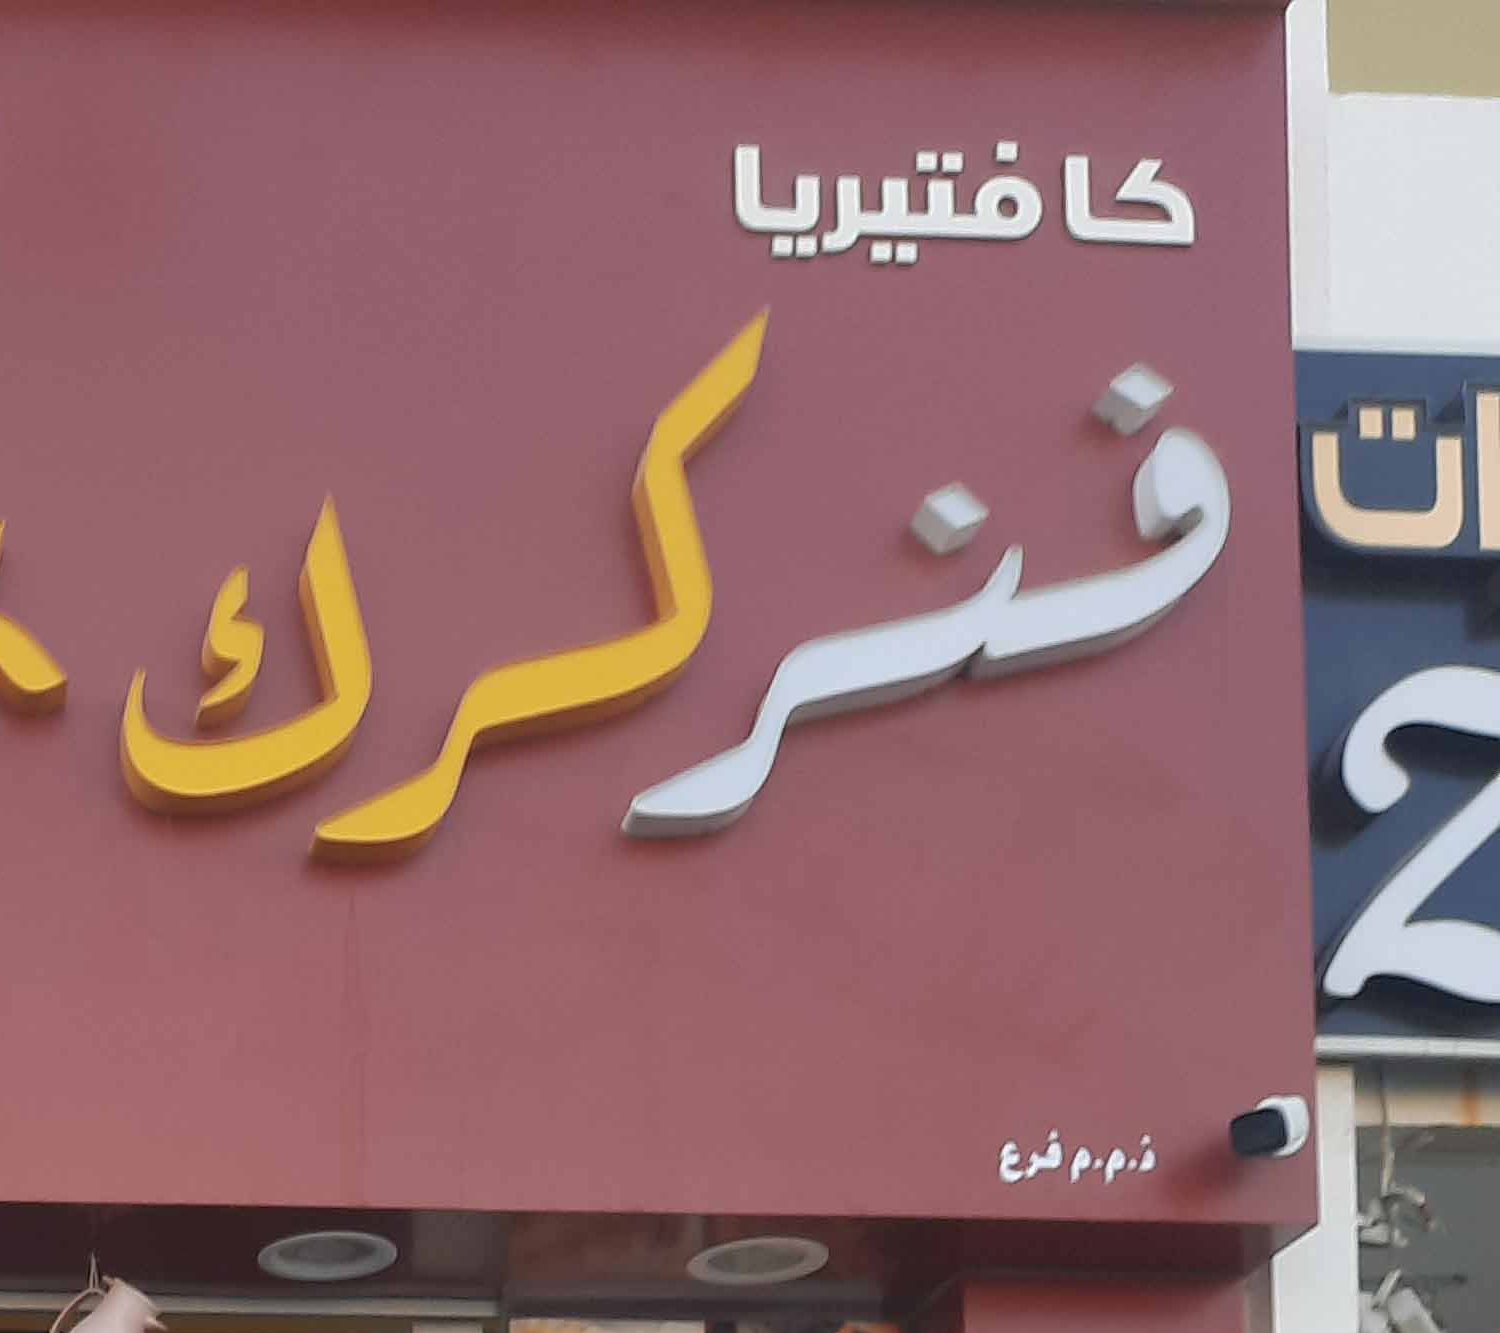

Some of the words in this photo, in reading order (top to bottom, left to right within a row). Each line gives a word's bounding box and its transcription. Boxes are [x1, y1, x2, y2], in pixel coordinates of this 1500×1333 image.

[732, 142, 1197, 263] كافتيريا
[121, 304, 770, 860] كرك
[999, 1128, 1064, 1183] فرع
